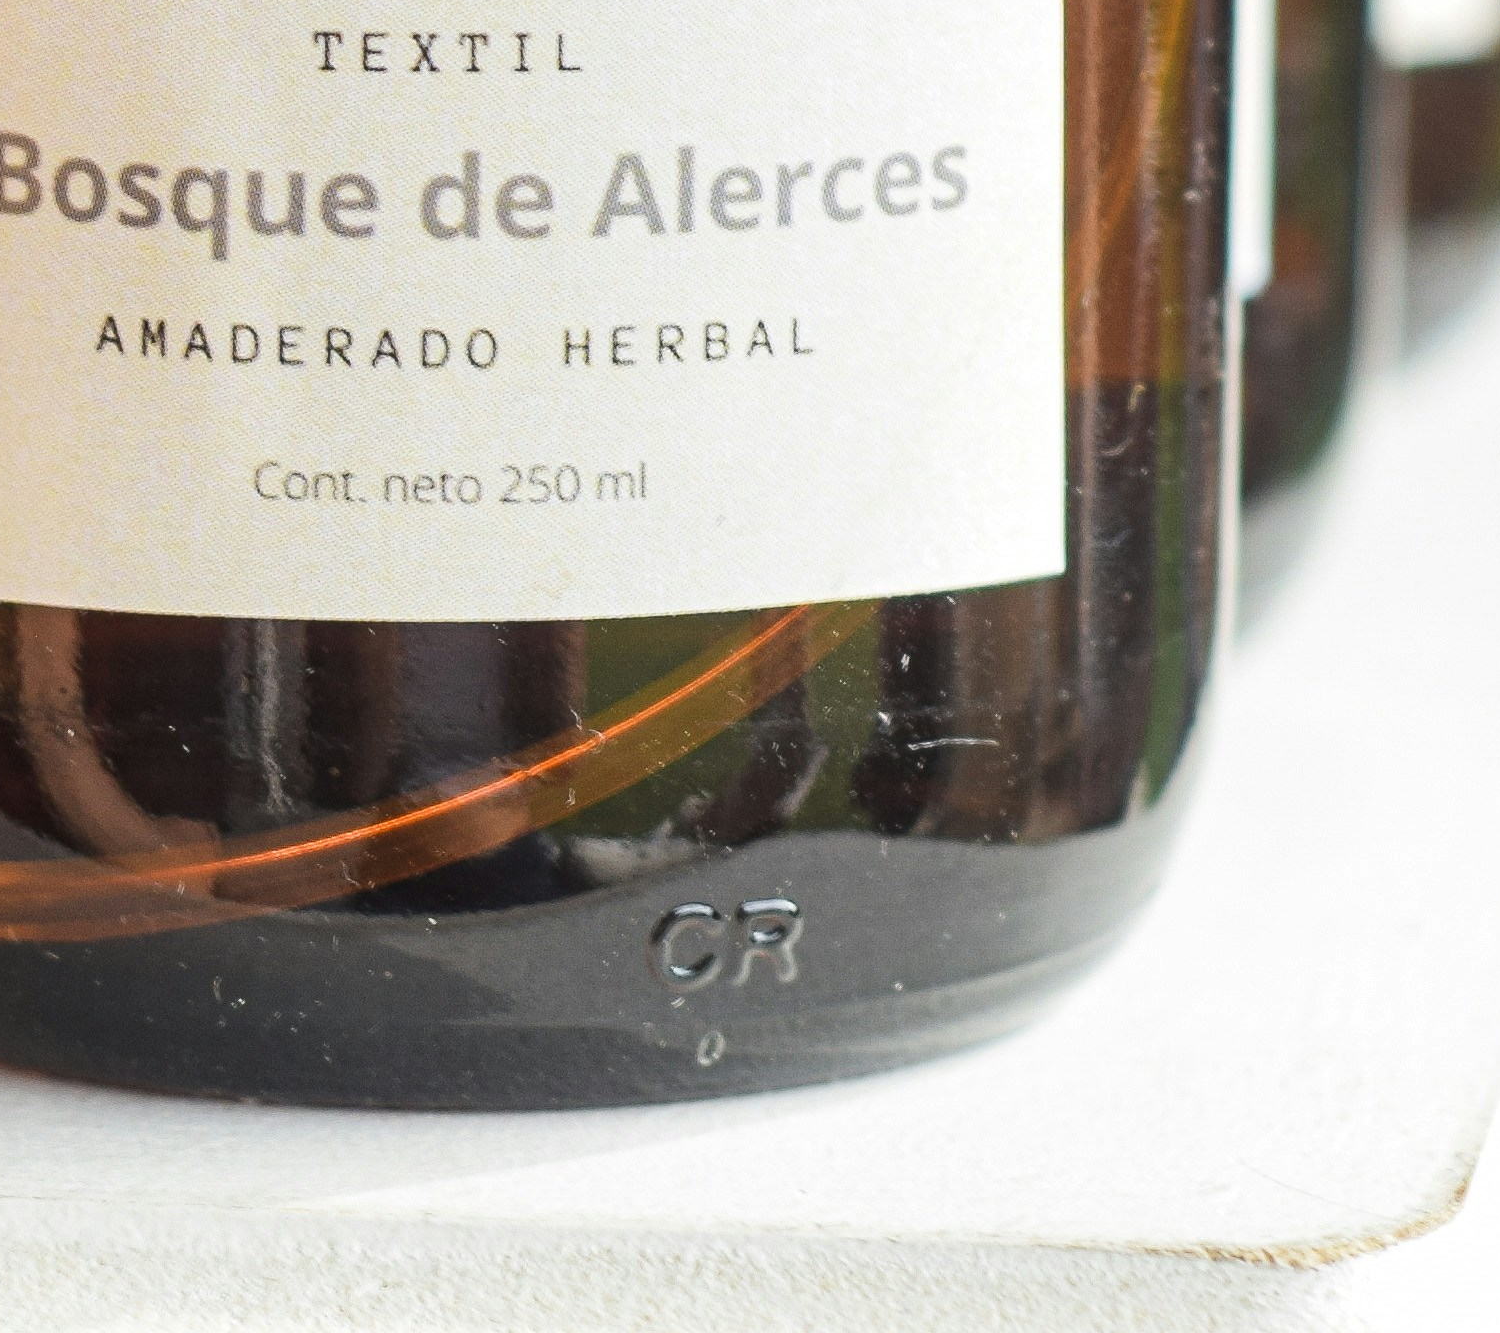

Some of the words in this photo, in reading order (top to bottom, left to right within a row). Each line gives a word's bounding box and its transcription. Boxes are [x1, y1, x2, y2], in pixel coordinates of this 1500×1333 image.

[311, 29, 583, 75] TEXTIL
[418, 149, 555, 242] de
[589, 144, 969, 239] Alerces
[94, 313, 499, 371] AMADERADO
[562, 317, 814, 368] HERBAL
[251, 459, 368, 505] Cont.
[381, 470, 484, 507] neto
[497, 462, 583, 507] 250
[594, 460, 649, 502] ml
